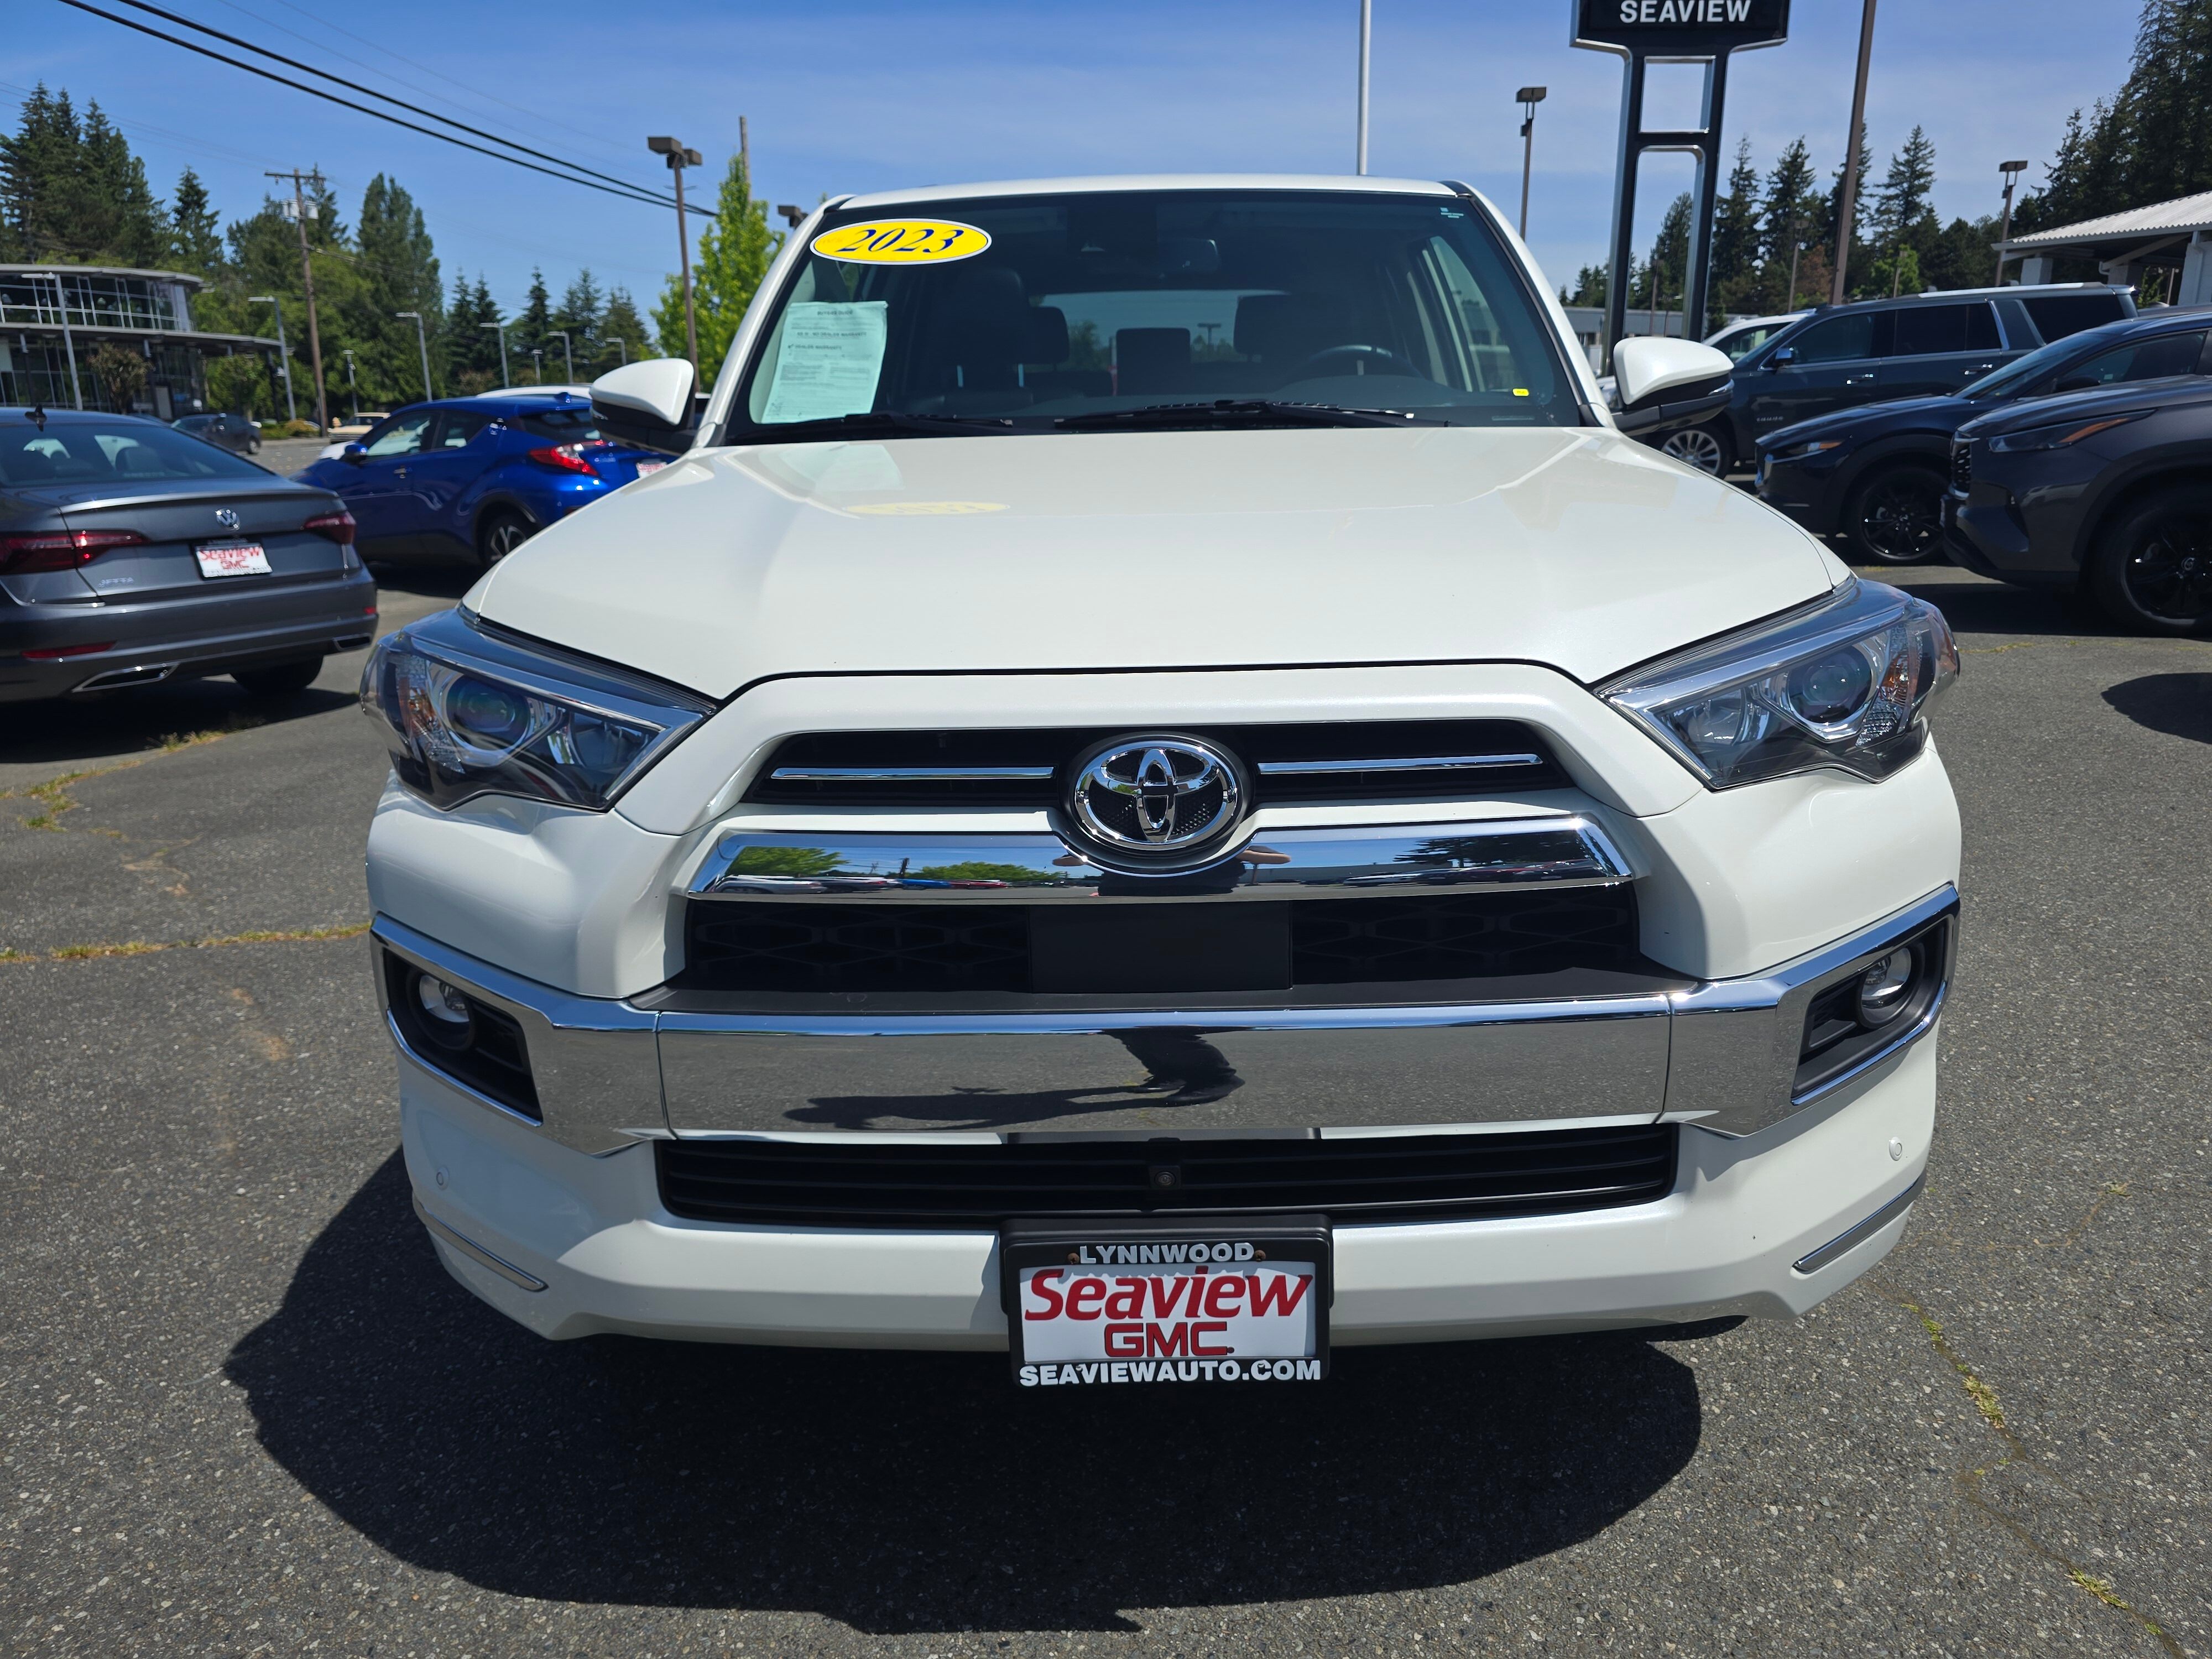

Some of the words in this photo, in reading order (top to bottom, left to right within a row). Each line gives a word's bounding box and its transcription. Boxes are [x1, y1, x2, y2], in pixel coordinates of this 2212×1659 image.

[1620, 0, 1751, 23] SEAVIEW
[834, 228, 965, 253] 2023
[1079, 1242, 1255, 1264] LYNNWOOD
[1025, 1265, 1314, 1321] Seaview
[1104, 1322, 1228, 1358] GMC
[1019, 1359, 1321, 1387] SEAVIEWAUTO.COM
